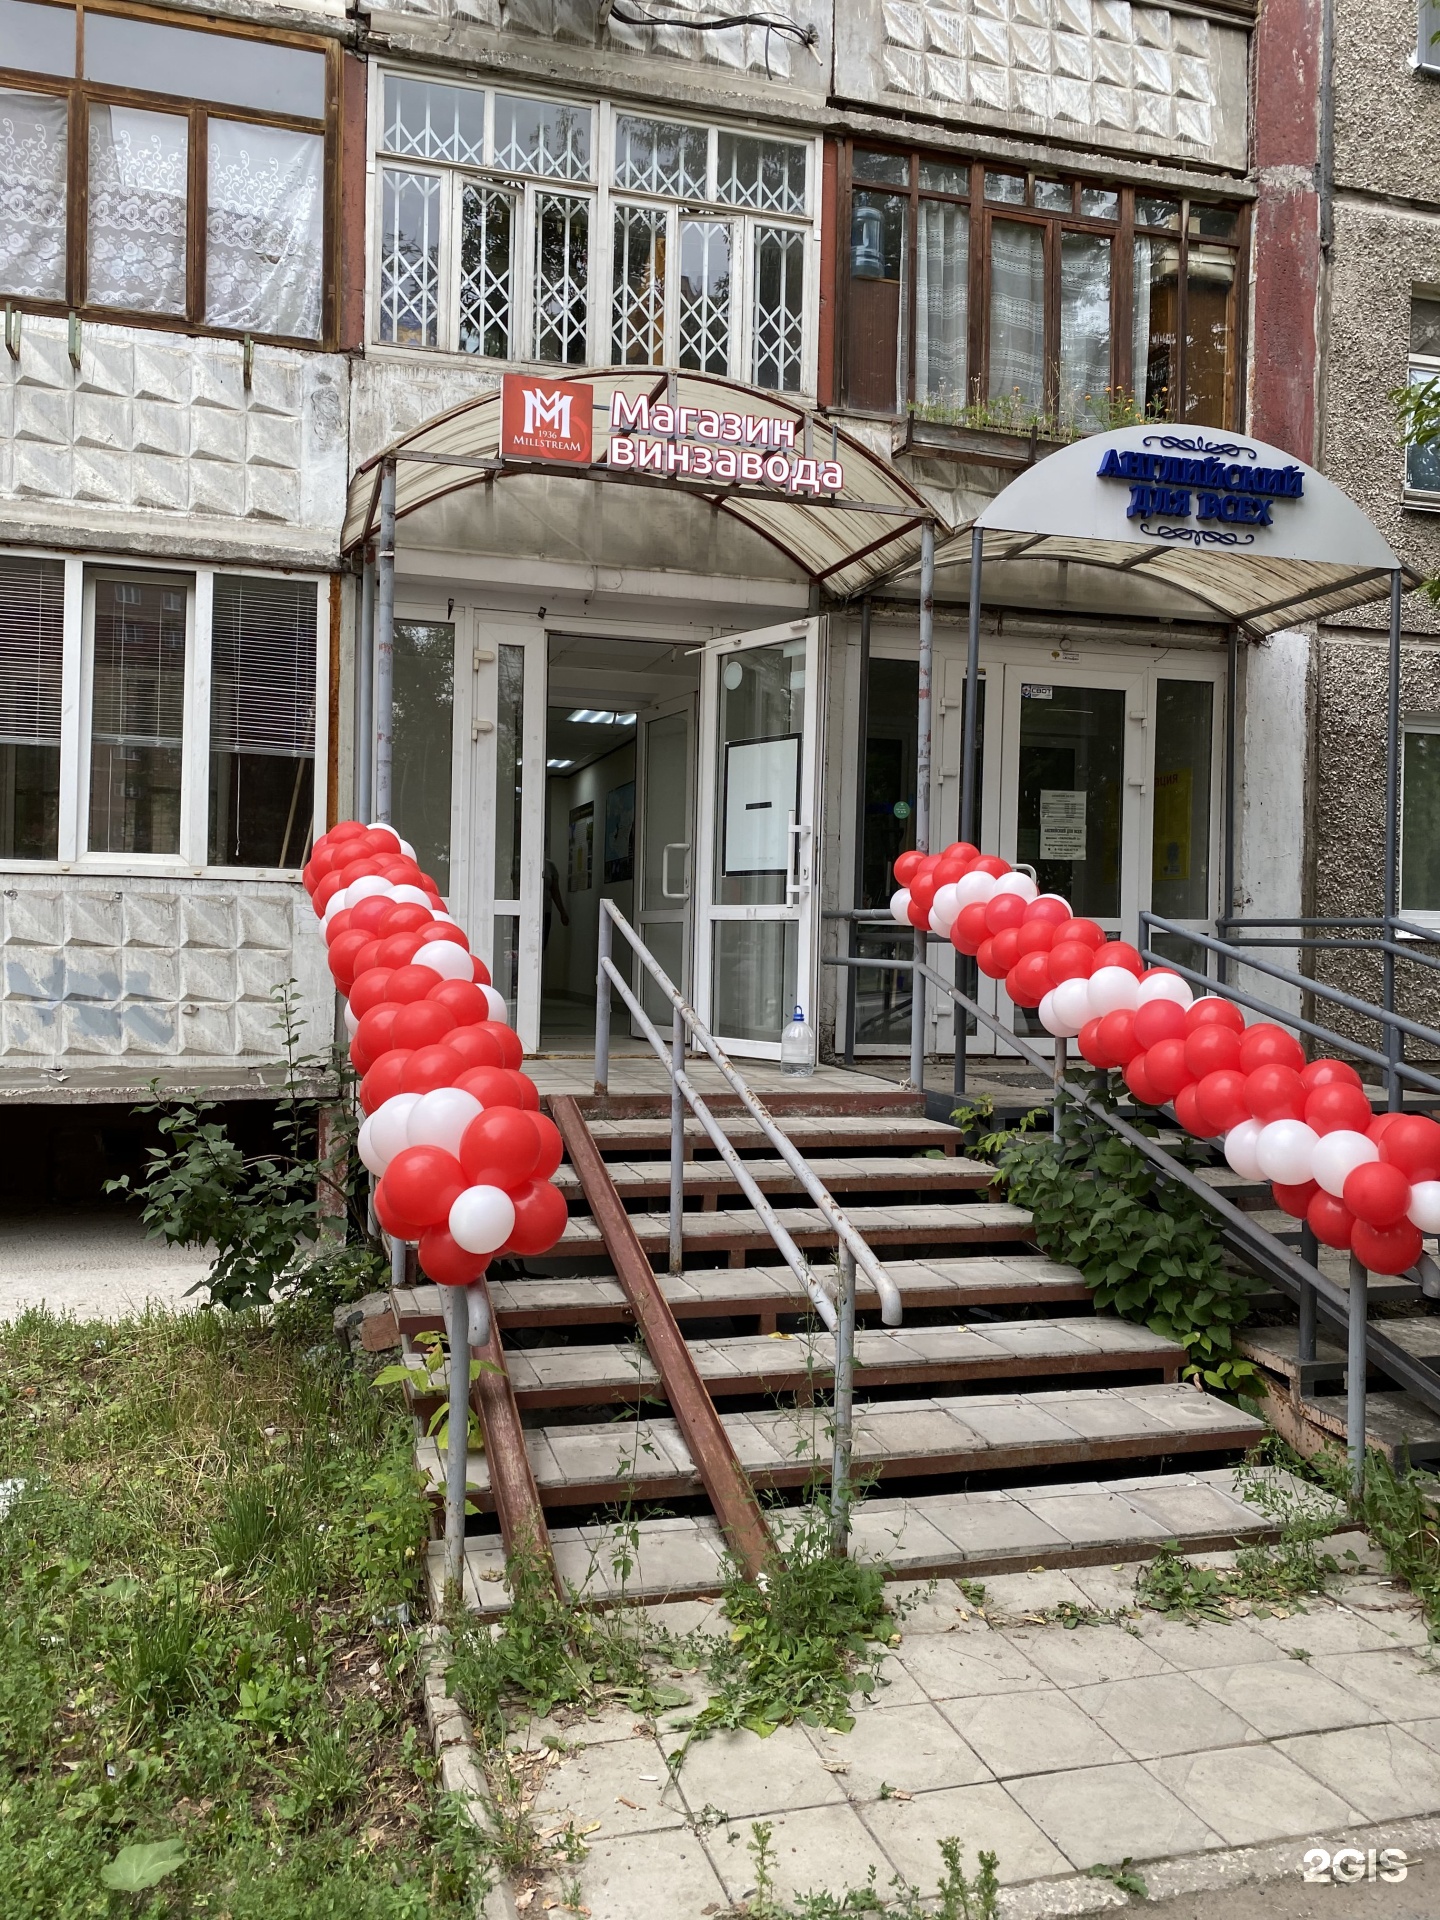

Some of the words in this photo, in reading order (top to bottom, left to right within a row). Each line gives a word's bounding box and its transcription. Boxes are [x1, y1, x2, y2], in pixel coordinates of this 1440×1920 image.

[538, 430, 557, 439] 1936
[610, 390, 796, 449] Магазин
[513, 434, 581, 452] MILLSTREAM
[1097, 449, 1304, 498] АНГЛИЙСКИЙ
[1127, 485, 1192, 519] ДЛЯ
[1196, 492, 1274, 526] ВСЕХ
